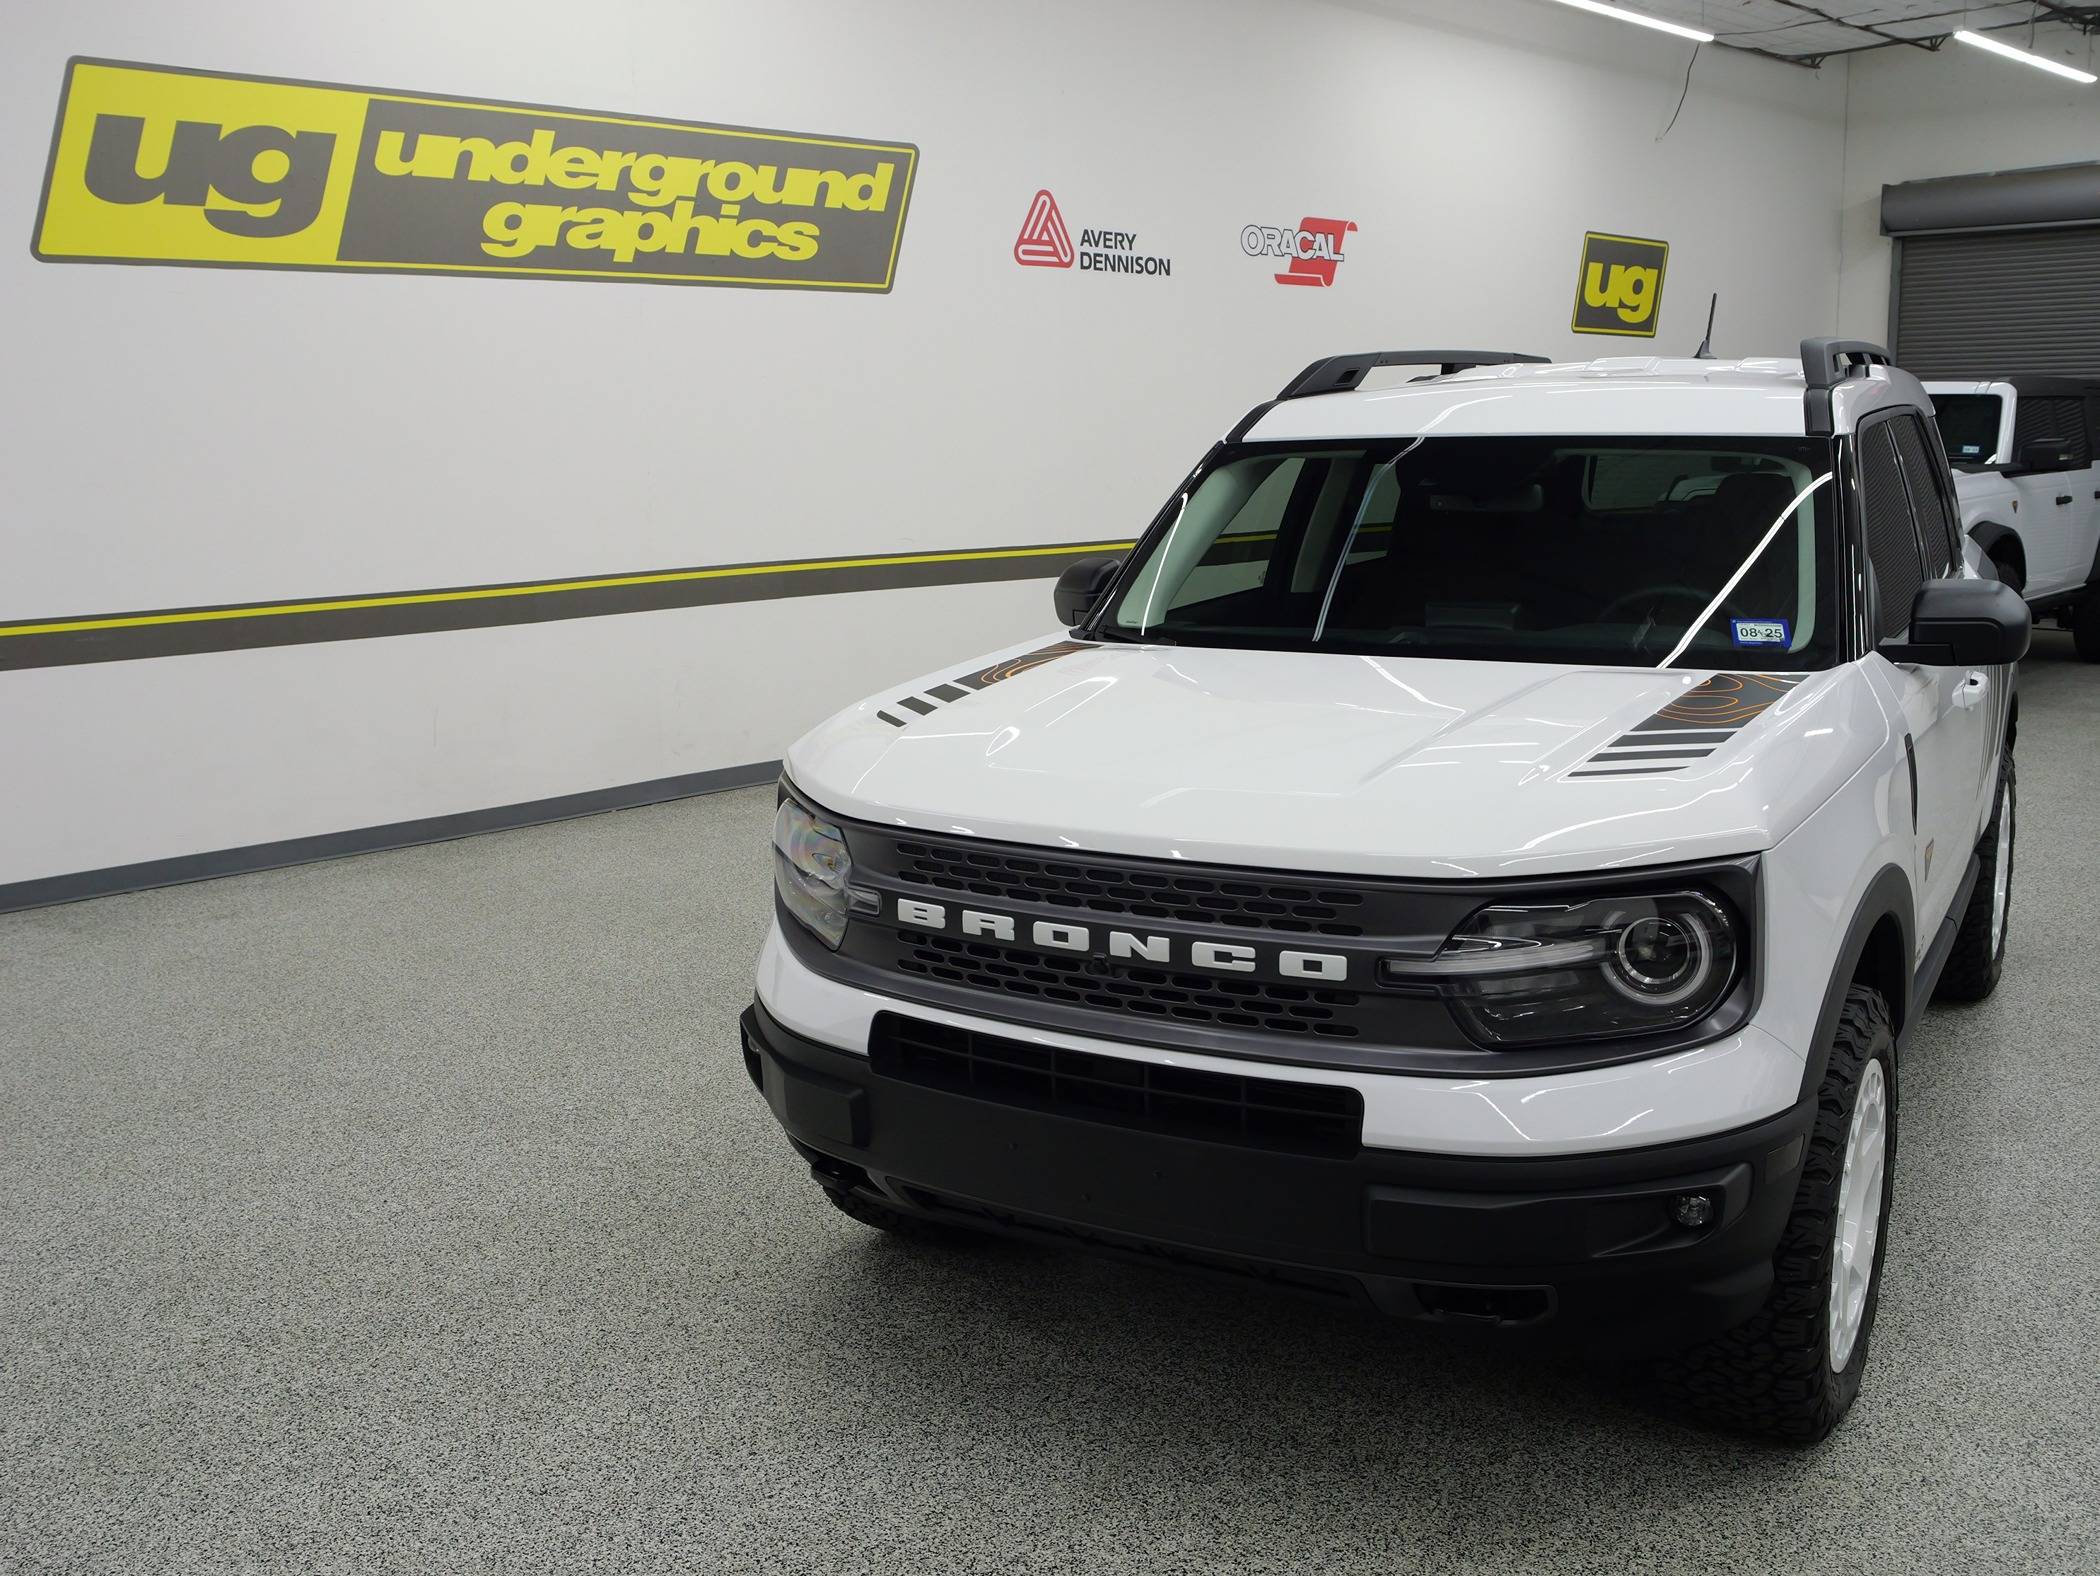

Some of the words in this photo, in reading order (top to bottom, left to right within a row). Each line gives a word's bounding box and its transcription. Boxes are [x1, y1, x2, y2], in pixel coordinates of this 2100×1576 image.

[85, 113, 337, 238] ug
[374, 130, 894, 212] underground
[482, 202, 819, 262] graphics
[1080, 229, 1137, 250] AVERY
[1240, 225, 1344, 262] ORACAL
[1080, 252, 1171, 276] DENNISON
[1584, 262, 1658, 323] ug
[897, 898, 1347, 981] BRONCO
